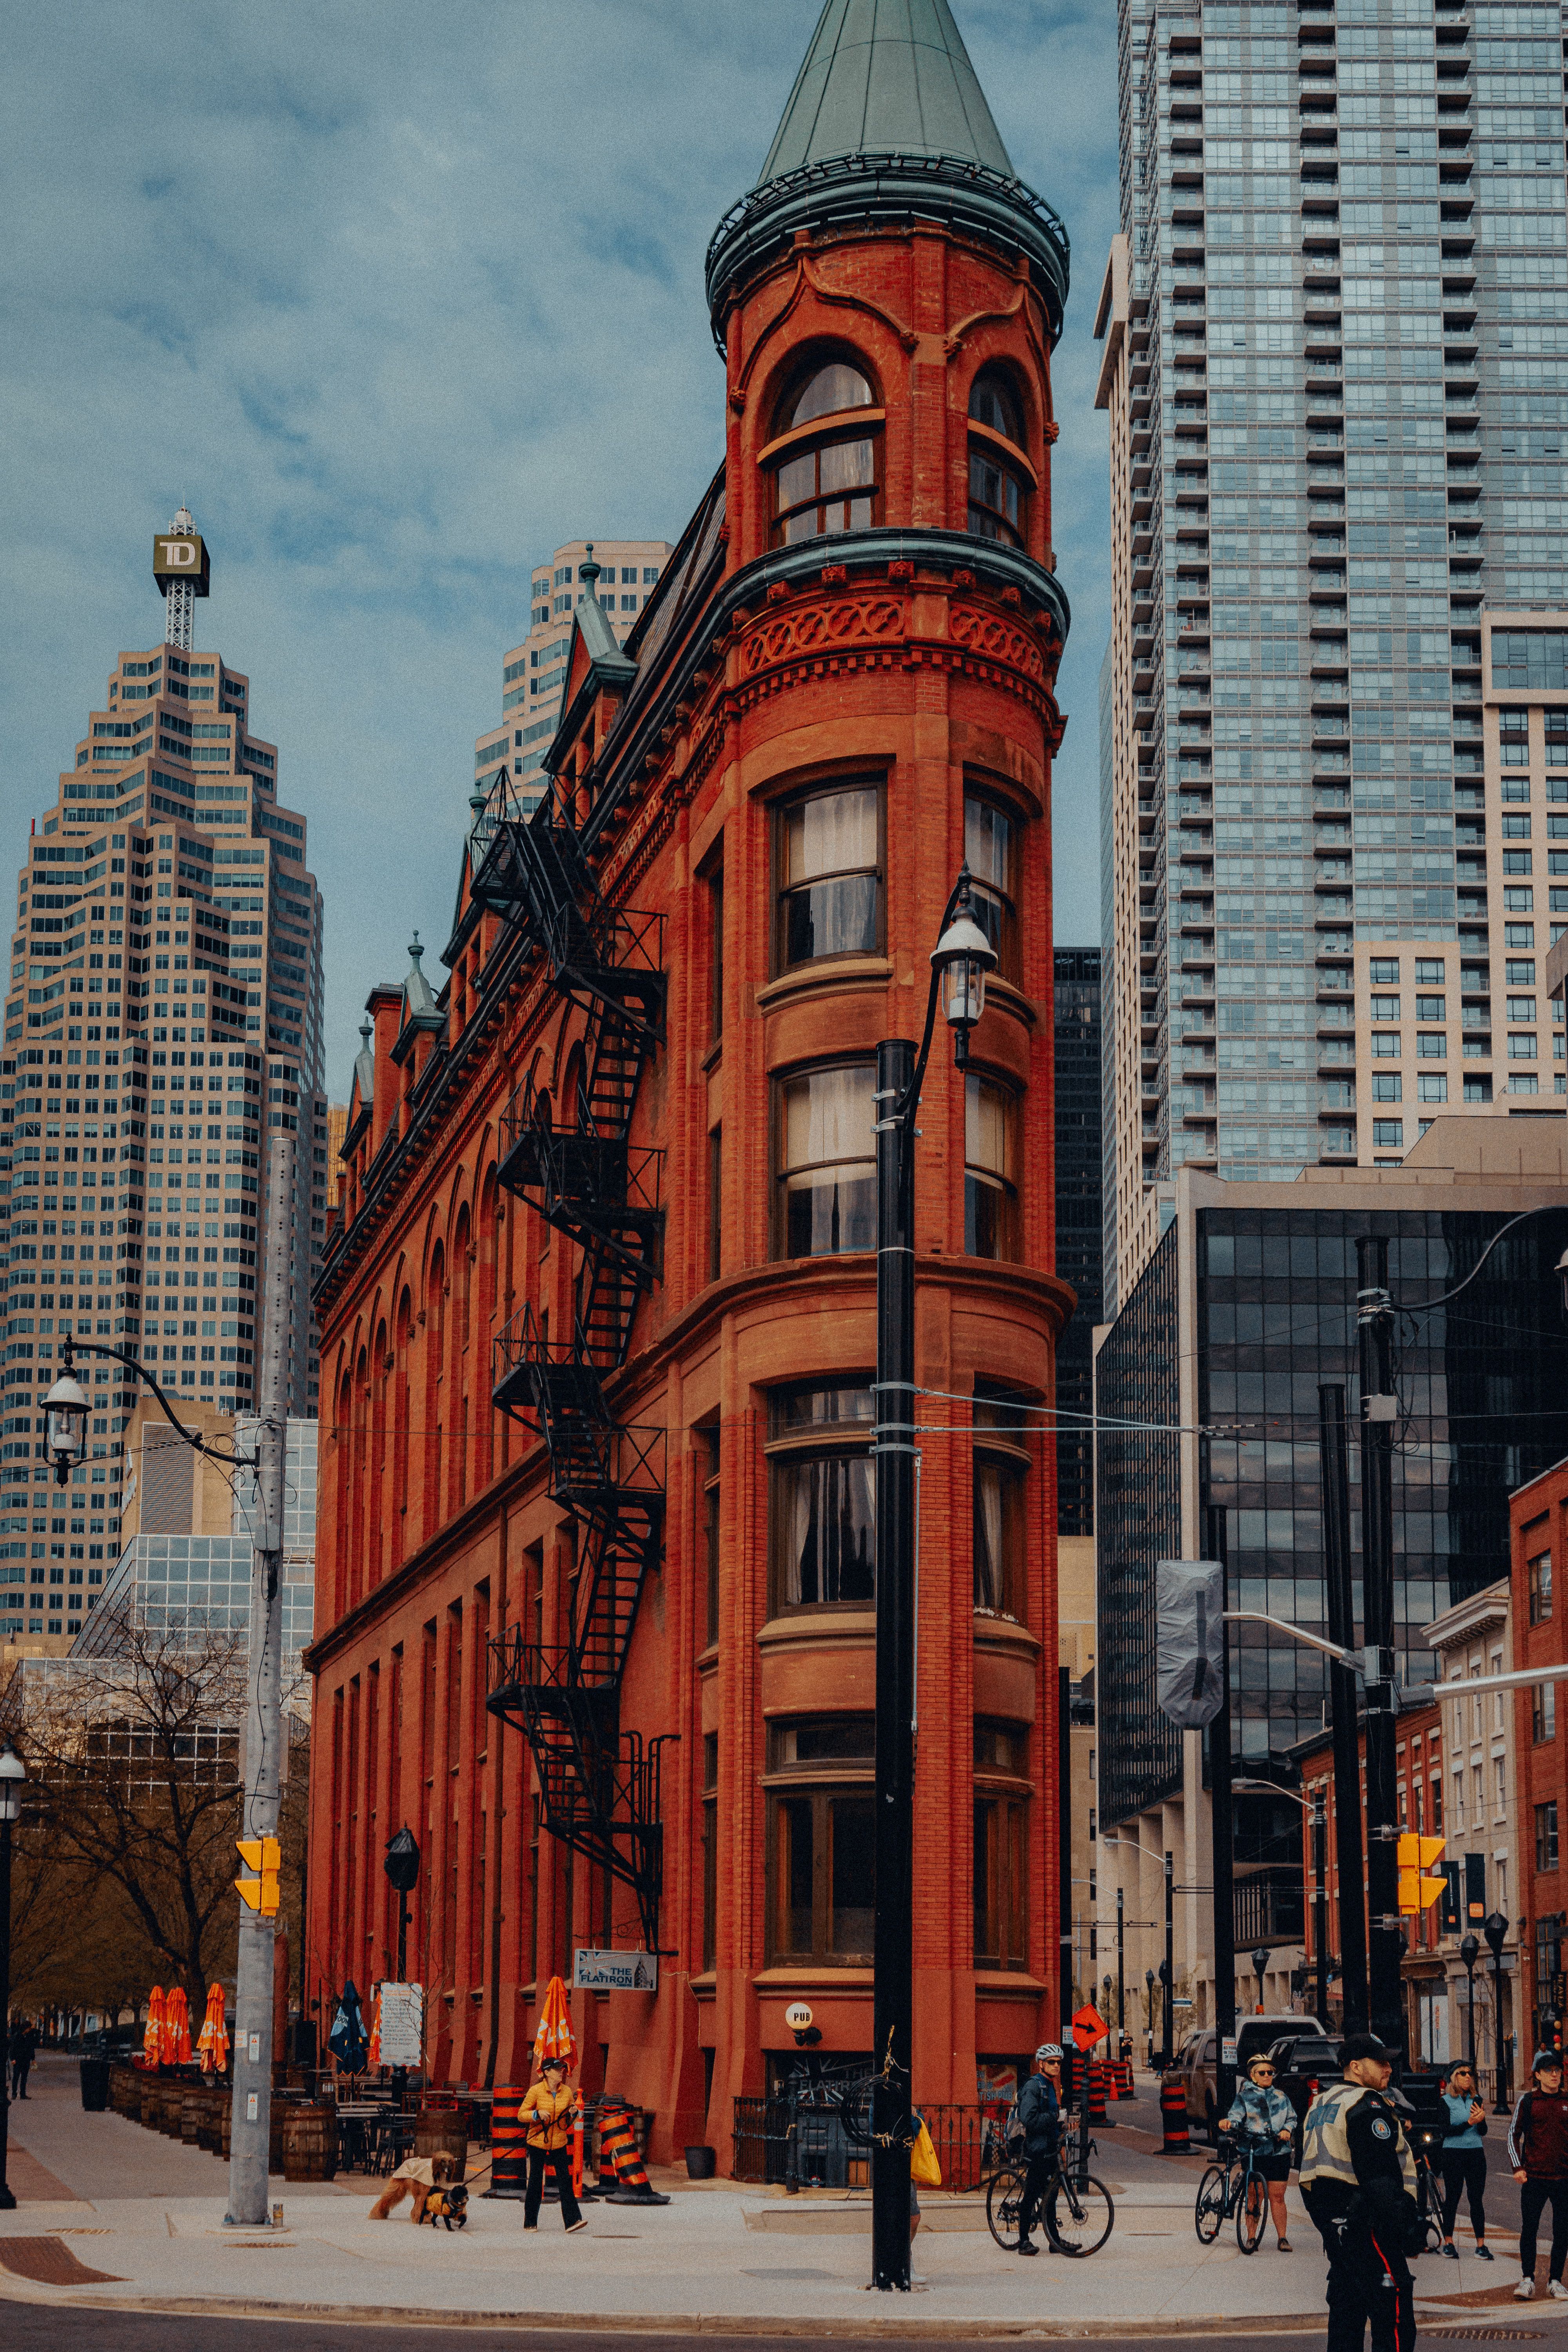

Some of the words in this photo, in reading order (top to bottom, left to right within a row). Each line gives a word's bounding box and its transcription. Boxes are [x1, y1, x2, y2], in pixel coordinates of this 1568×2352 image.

[160, 542, 196, 566] TD
[610, 1967, 632, 1976] THE
[581, 1975, 632, 1984] FLATIRON
[794, 2013, 810, 2022] PUB
[997, 2091, 1013, 2100] PUB
